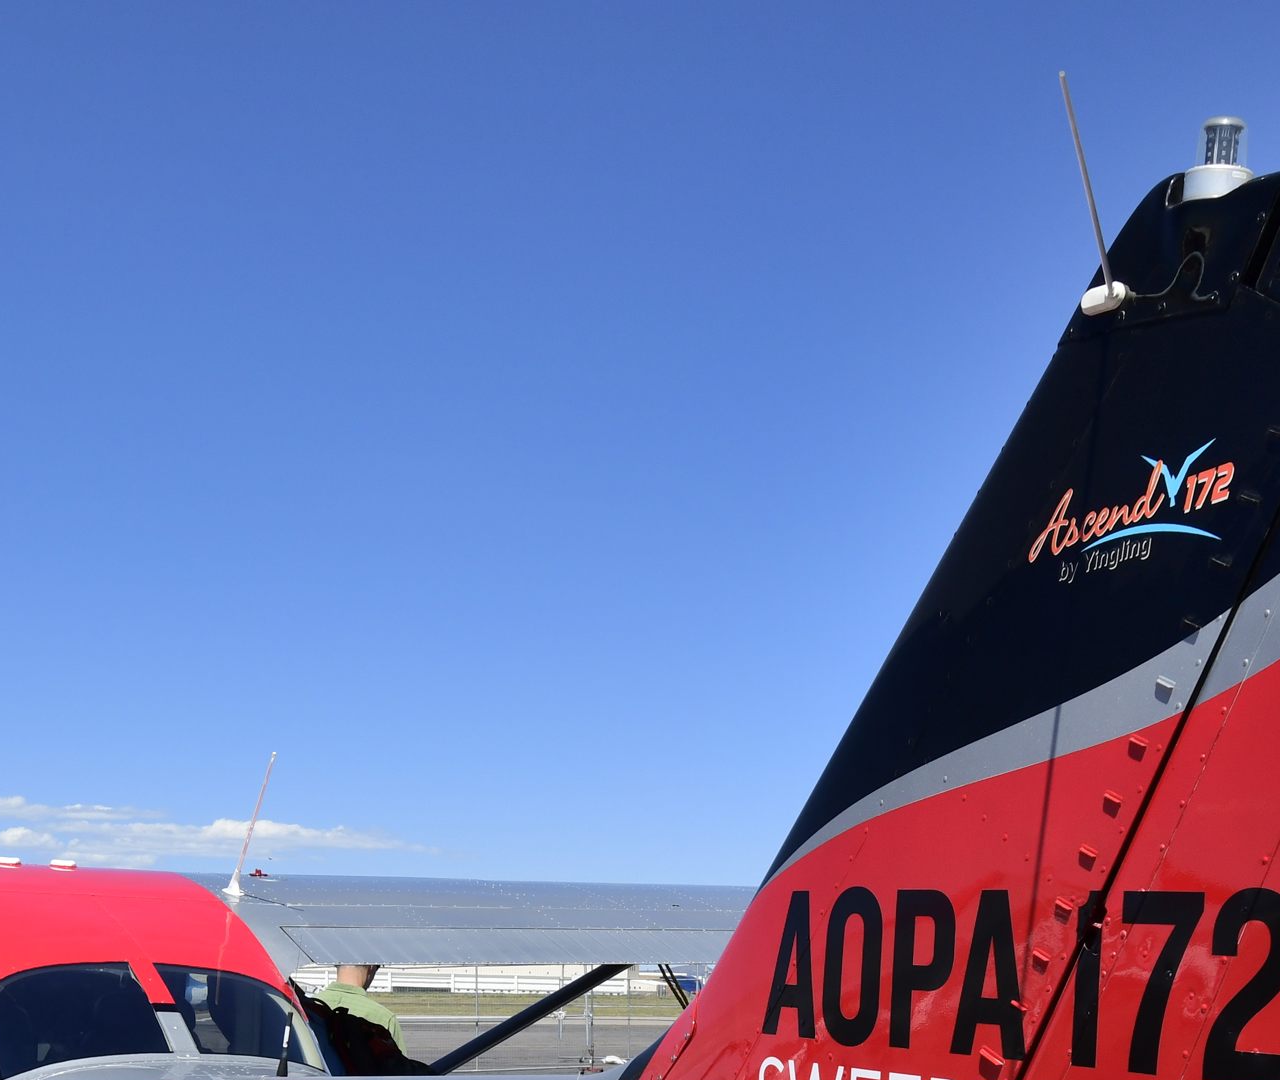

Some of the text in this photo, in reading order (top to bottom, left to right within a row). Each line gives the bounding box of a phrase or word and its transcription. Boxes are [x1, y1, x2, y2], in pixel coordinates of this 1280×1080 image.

[1028, 459, 1235, 564] Ascend 172
[1058, 537, 1153, 584] by Yingling
[762, 886, 1026, 1062] AOPA
